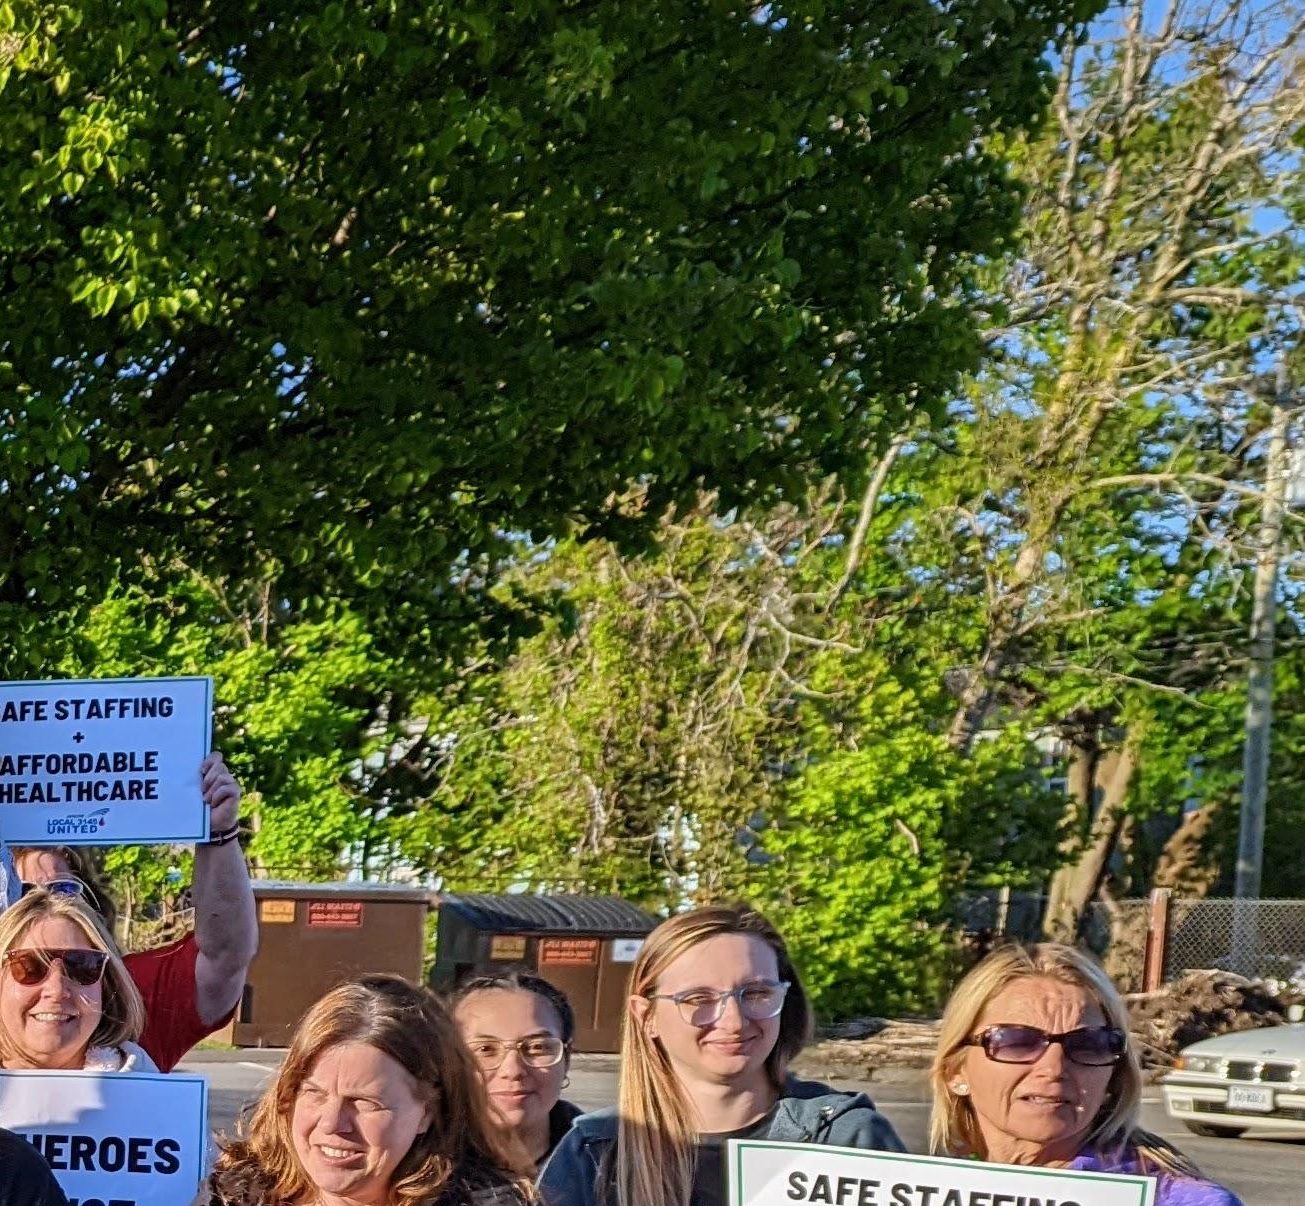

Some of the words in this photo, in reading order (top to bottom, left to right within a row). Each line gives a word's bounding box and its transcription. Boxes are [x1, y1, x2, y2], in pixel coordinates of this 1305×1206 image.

[54, 696, 174, 721] STAFFING
[72, 731, 85, 744] +
[0, 751, 159, 776] AFFORDABLE
[47, 825, 98, 834] UNITED
